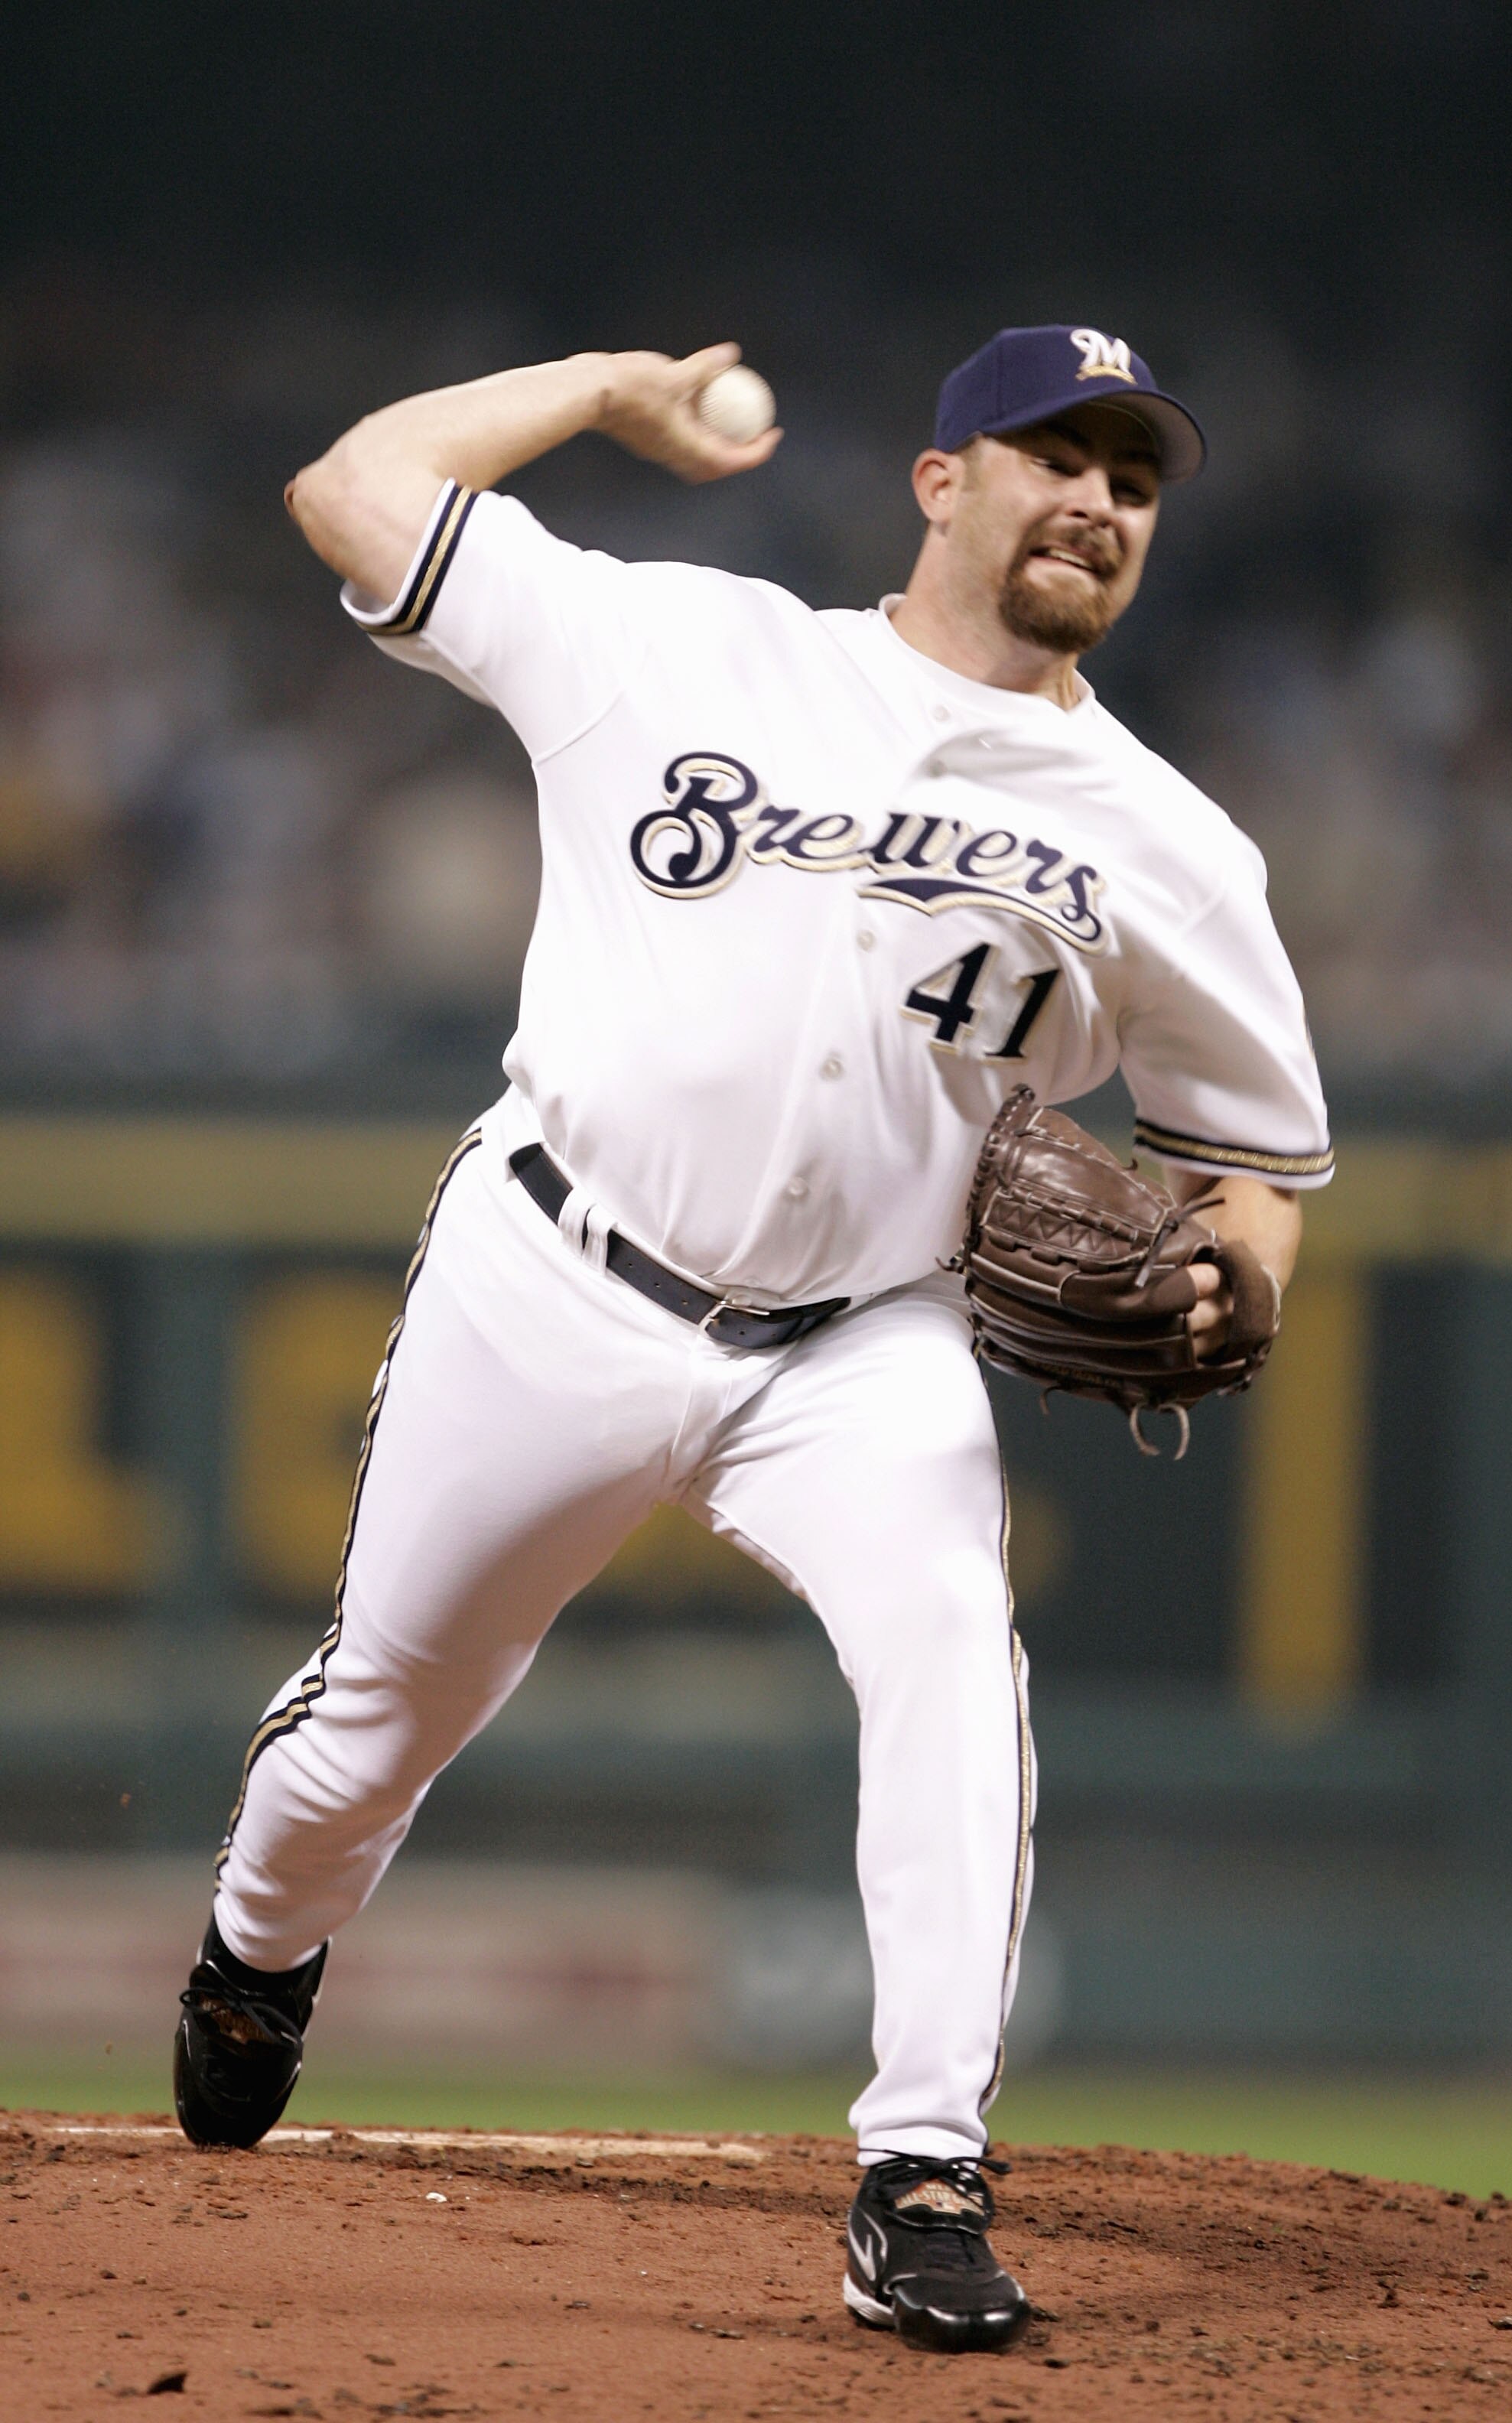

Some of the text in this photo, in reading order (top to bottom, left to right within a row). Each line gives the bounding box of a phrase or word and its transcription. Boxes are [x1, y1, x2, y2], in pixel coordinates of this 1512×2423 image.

[1070, 328, 1134, 378] M
[629, 750, 1107, 929] Brewers
[900, 942, 1061, 1062] 41
